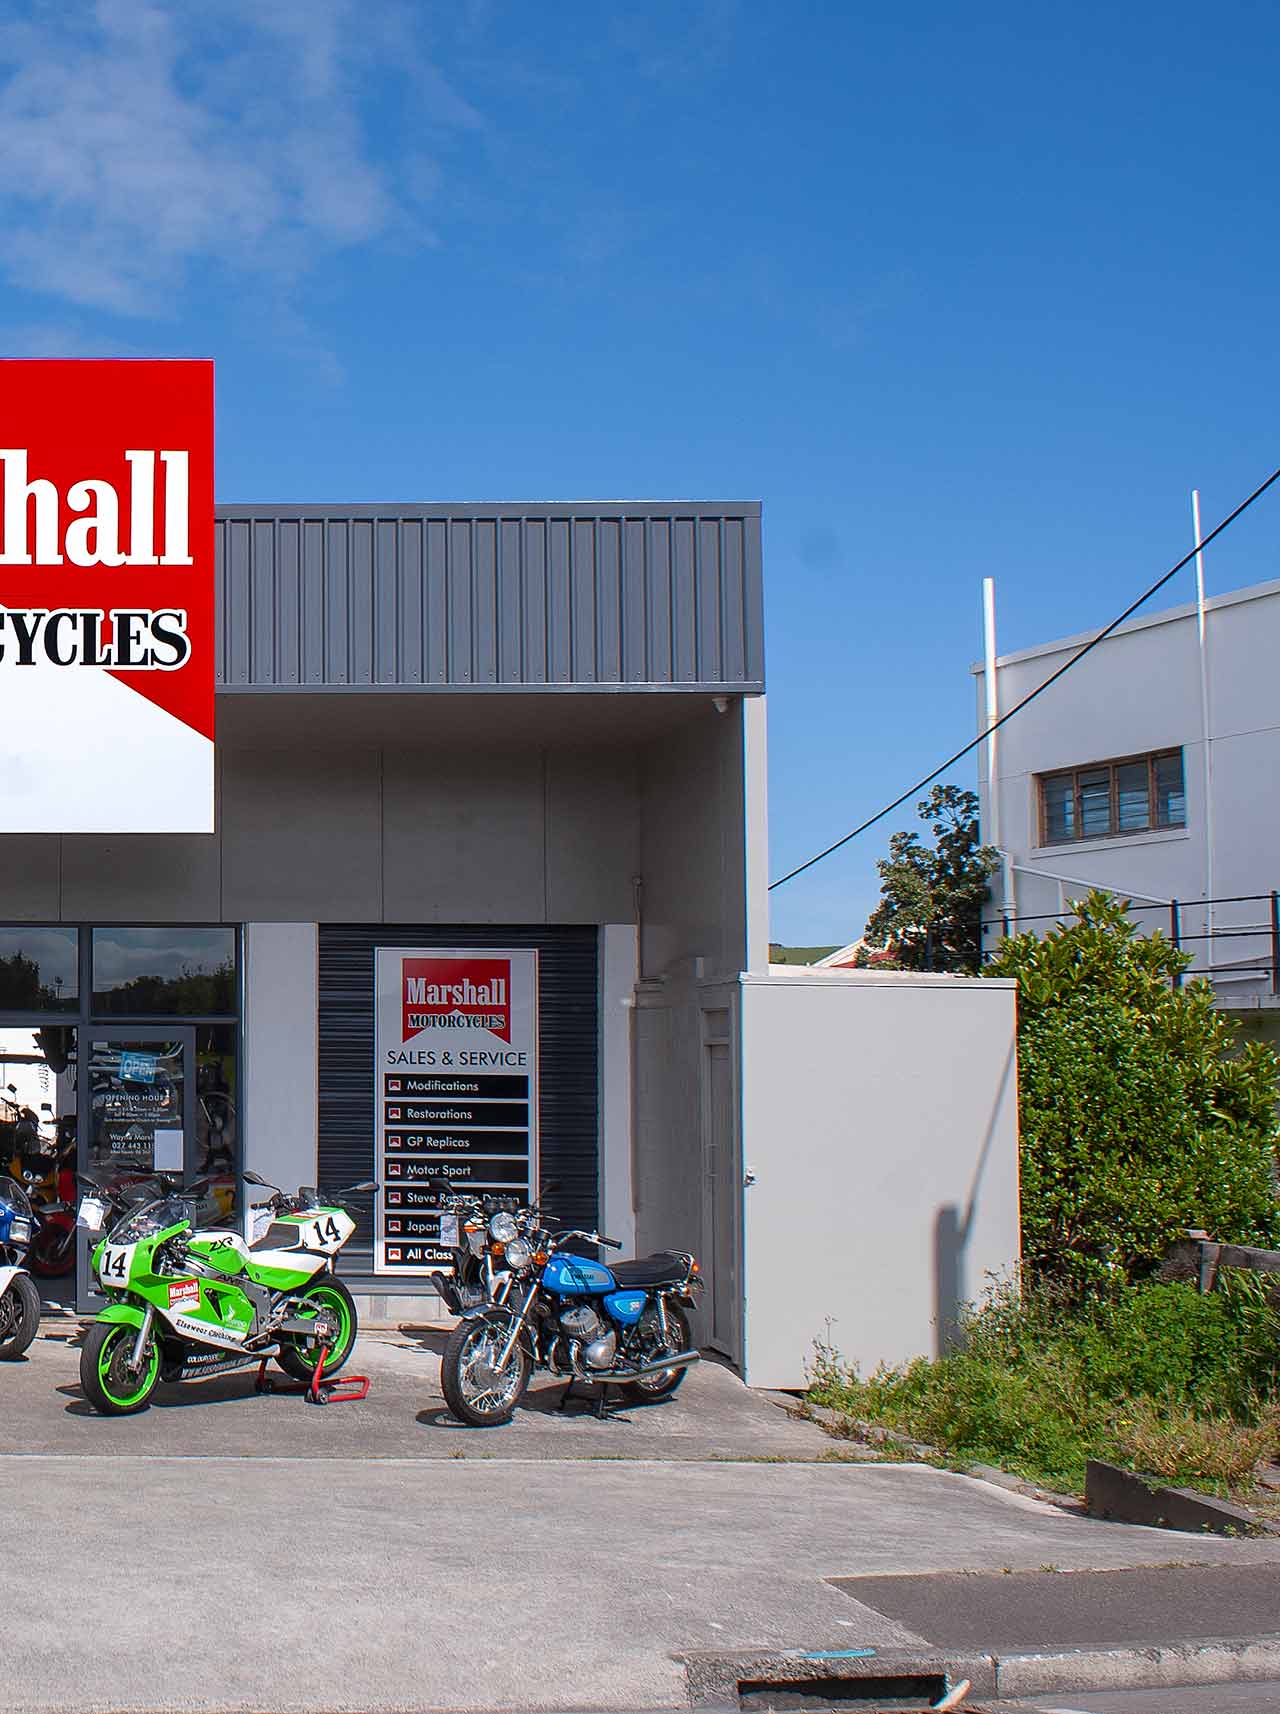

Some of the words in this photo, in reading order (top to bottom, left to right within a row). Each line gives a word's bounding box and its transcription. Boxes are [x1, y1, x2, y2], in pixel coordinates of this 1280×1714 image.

[406, 977, 507, 1006] Marshall
[408, 1014, 506, 1029] MOTORCYCLES
[387, 1050, 436, 1066] SALES
[441, 1051, 454, 1066] &
[459, 1051, 528, 1067] SERVICE
[406, 1080, 480, 1092] Modifications
[406, 1108, 473, 1120] Restorations
[407, 1136, 424, 1147] GP
[426, 1136, 471, 1150] Replicas
[406, 1164, 440, 1176] Motor
[441, 1164, 472, 1178] Sport
[406, 1192, 436, 1204] Steve
[312, 1215, 342, 1246] 14
[209, 1236, 234, 1251] ZXR
[406, 1247, 421, 1260] All
[102, 1250, 127, 1278] 14
[169, 1282, 199, 1298] Marshall
